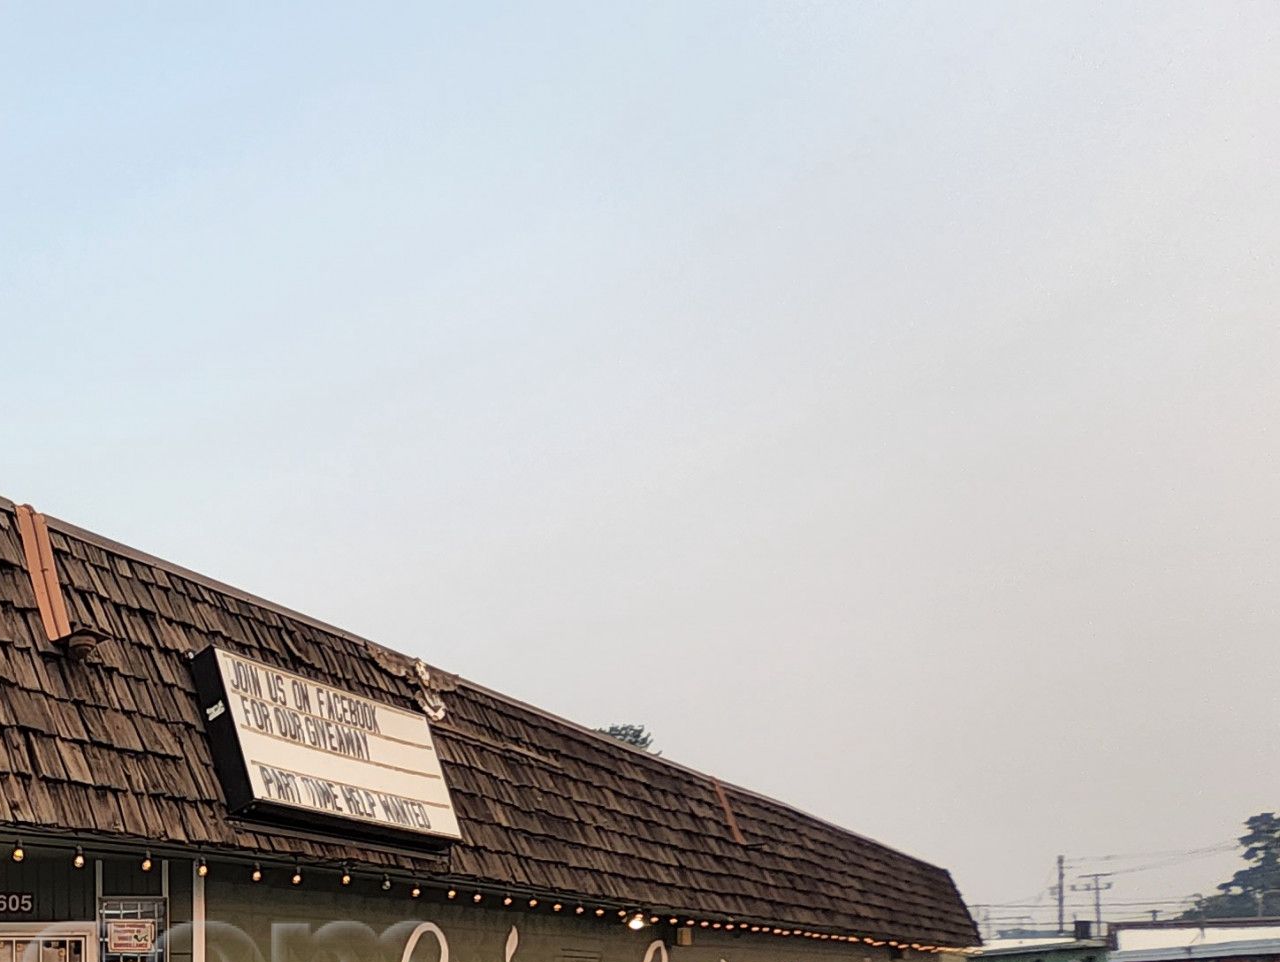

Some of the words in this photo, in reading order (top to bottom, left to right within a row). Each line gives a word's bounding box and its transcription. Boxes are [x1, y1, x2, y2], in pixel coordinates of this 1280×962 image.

[230, 660, 263, 698] JOIN
[265, 669, 288, 706] US
[291, 680, 313, 714] ON
[316, 688, 382, 734] FACEBOOK
[239, 696, 274, 734] FOR
[277, 707, 306, 742] OUR
[305, 716, 371, 761] GIVEAWAY
[259, 765, 303, 804] PART
[301, 776, 343, 812] TIME
[339, 784, 377, 819] HELP
[380, 795, 432, 830] WANTED
